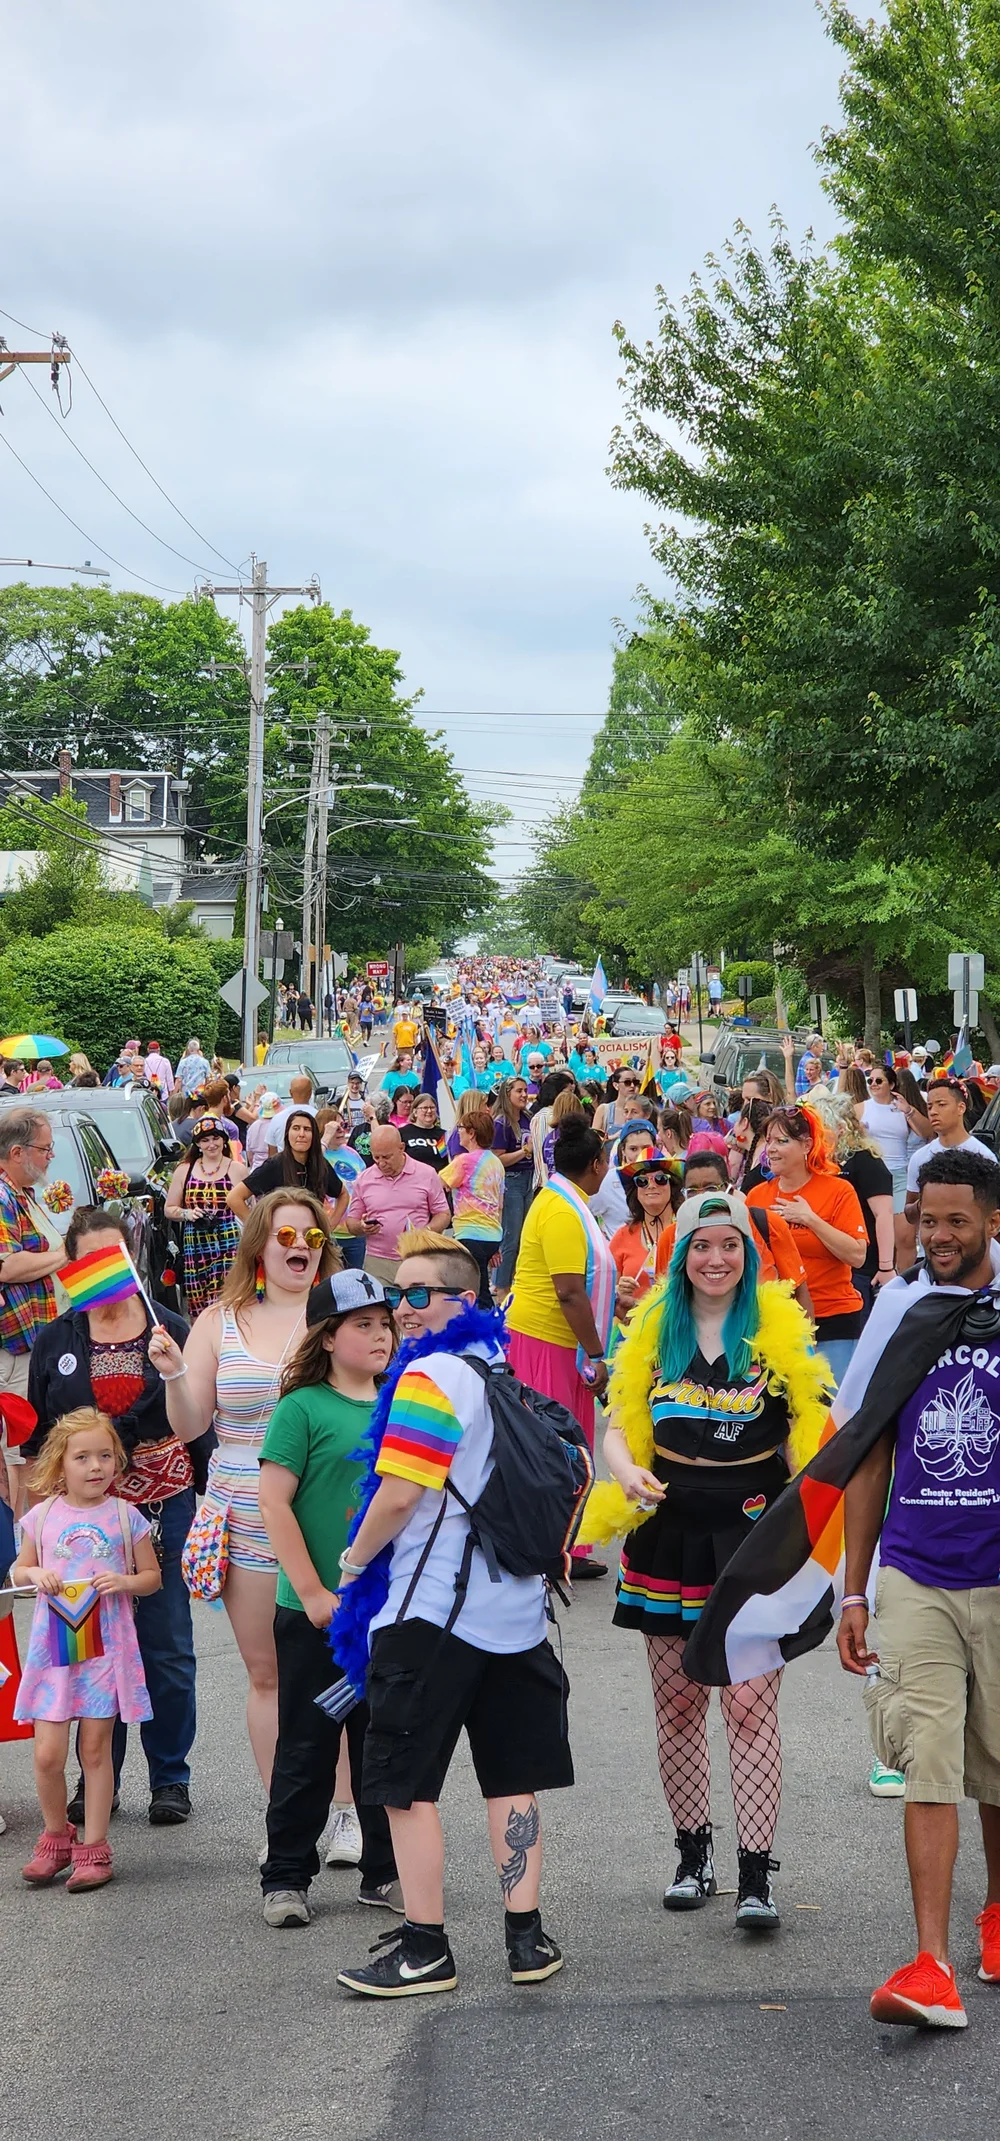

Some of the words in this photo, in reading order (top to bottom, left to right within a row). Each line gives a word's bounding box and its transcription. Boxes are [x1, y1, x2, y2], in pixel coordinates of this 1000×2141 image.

[599, 1042, 648, 1053] OCIALISM
[714, 1421, 744, 1441] AF
[920, 1487, 953, 1497] Chester
[955, 1487, 995, 1497] Residents
[899, 1496, 944, 1506] Concerned
[945, 1497, 958, 1506] for
[959, 1497, 991, 1506] Quality
